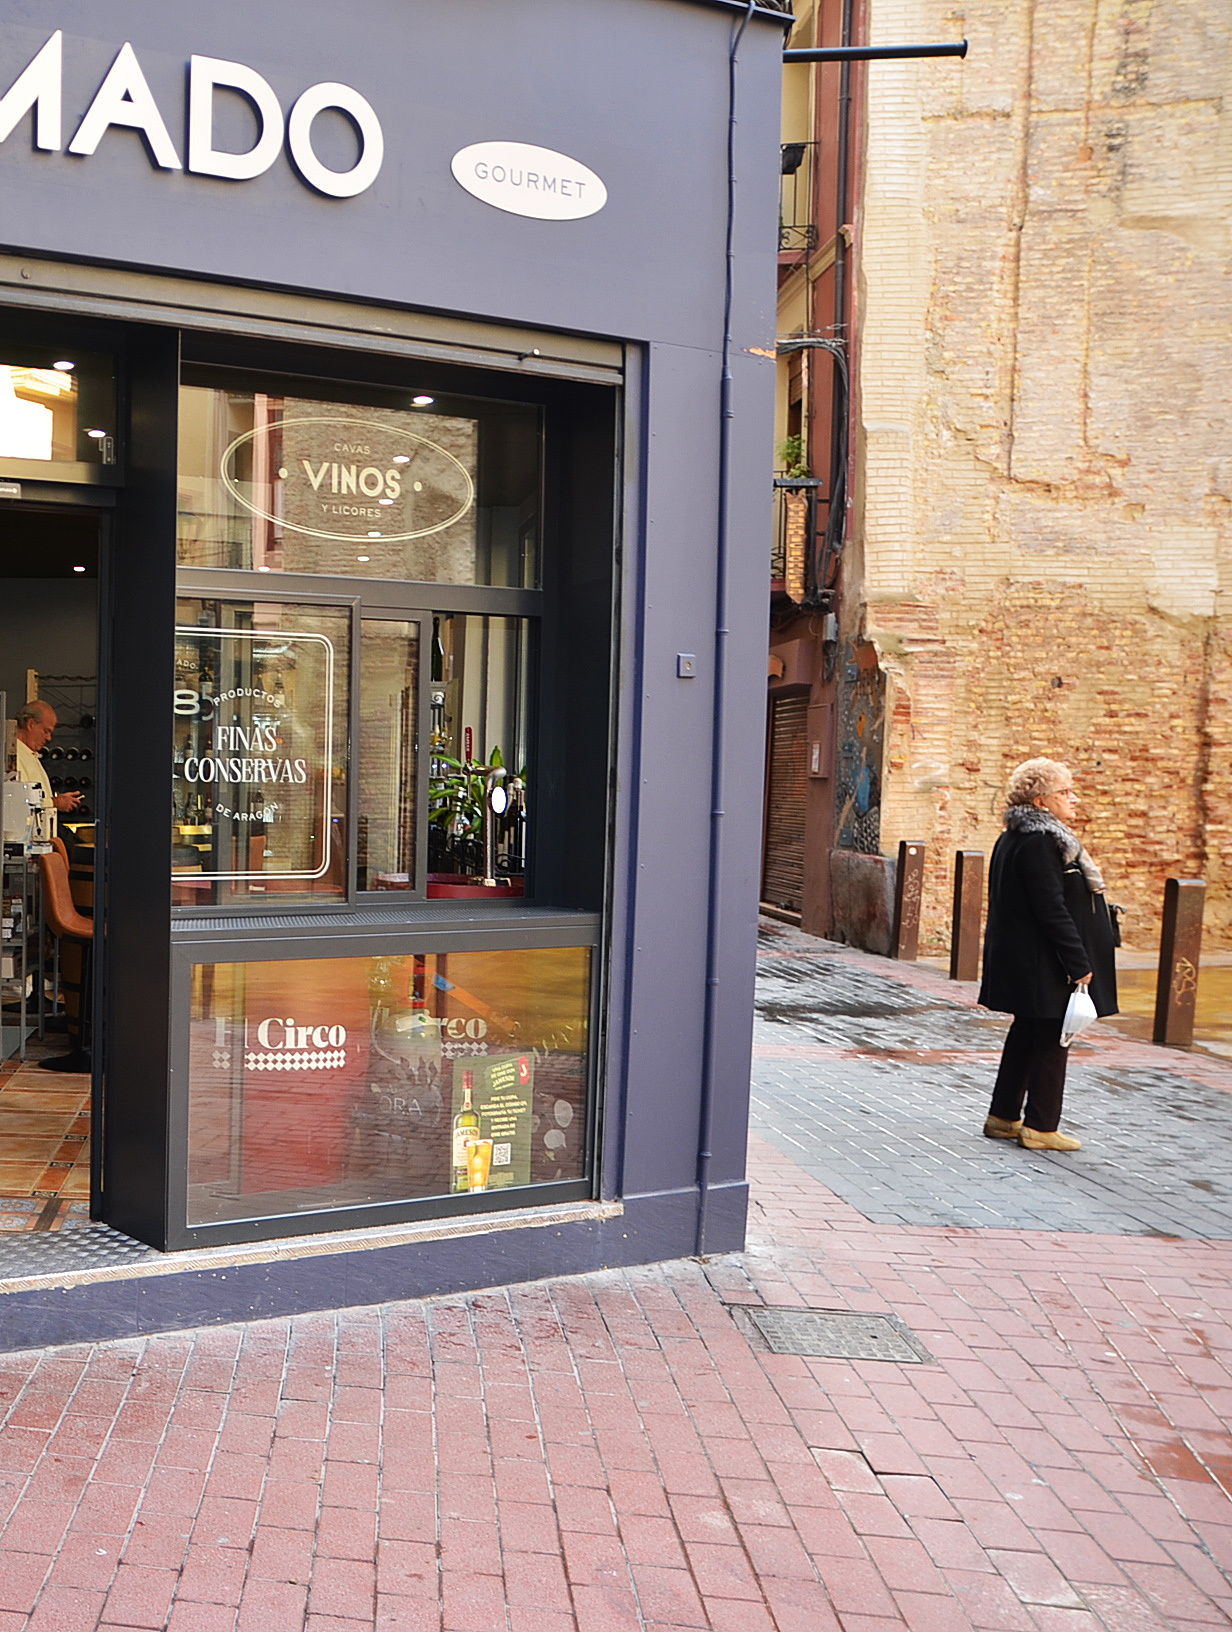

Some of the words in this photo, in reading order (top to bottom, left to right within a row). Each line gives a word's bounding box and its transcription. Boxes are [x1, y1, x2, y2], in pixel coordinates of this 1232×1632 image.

[474, 161, 587, 199] GOURMET
[333, 443, 371, 455] CAVAS
[302, 460, 401, 499] VINOS
[321, 503, 329, 513] Y
[332, 505, 382, 518] LICORES
[213, 687, 283, 709] PRODUCTOS
[217, 725, 277, 752] FINAS
[184, 757, 307, 783] CONSERVAS
[215, 803, 232, 818] DE
[257, 1017, 347, 1050] Circo
[520, 1064, 528, 1077] J
